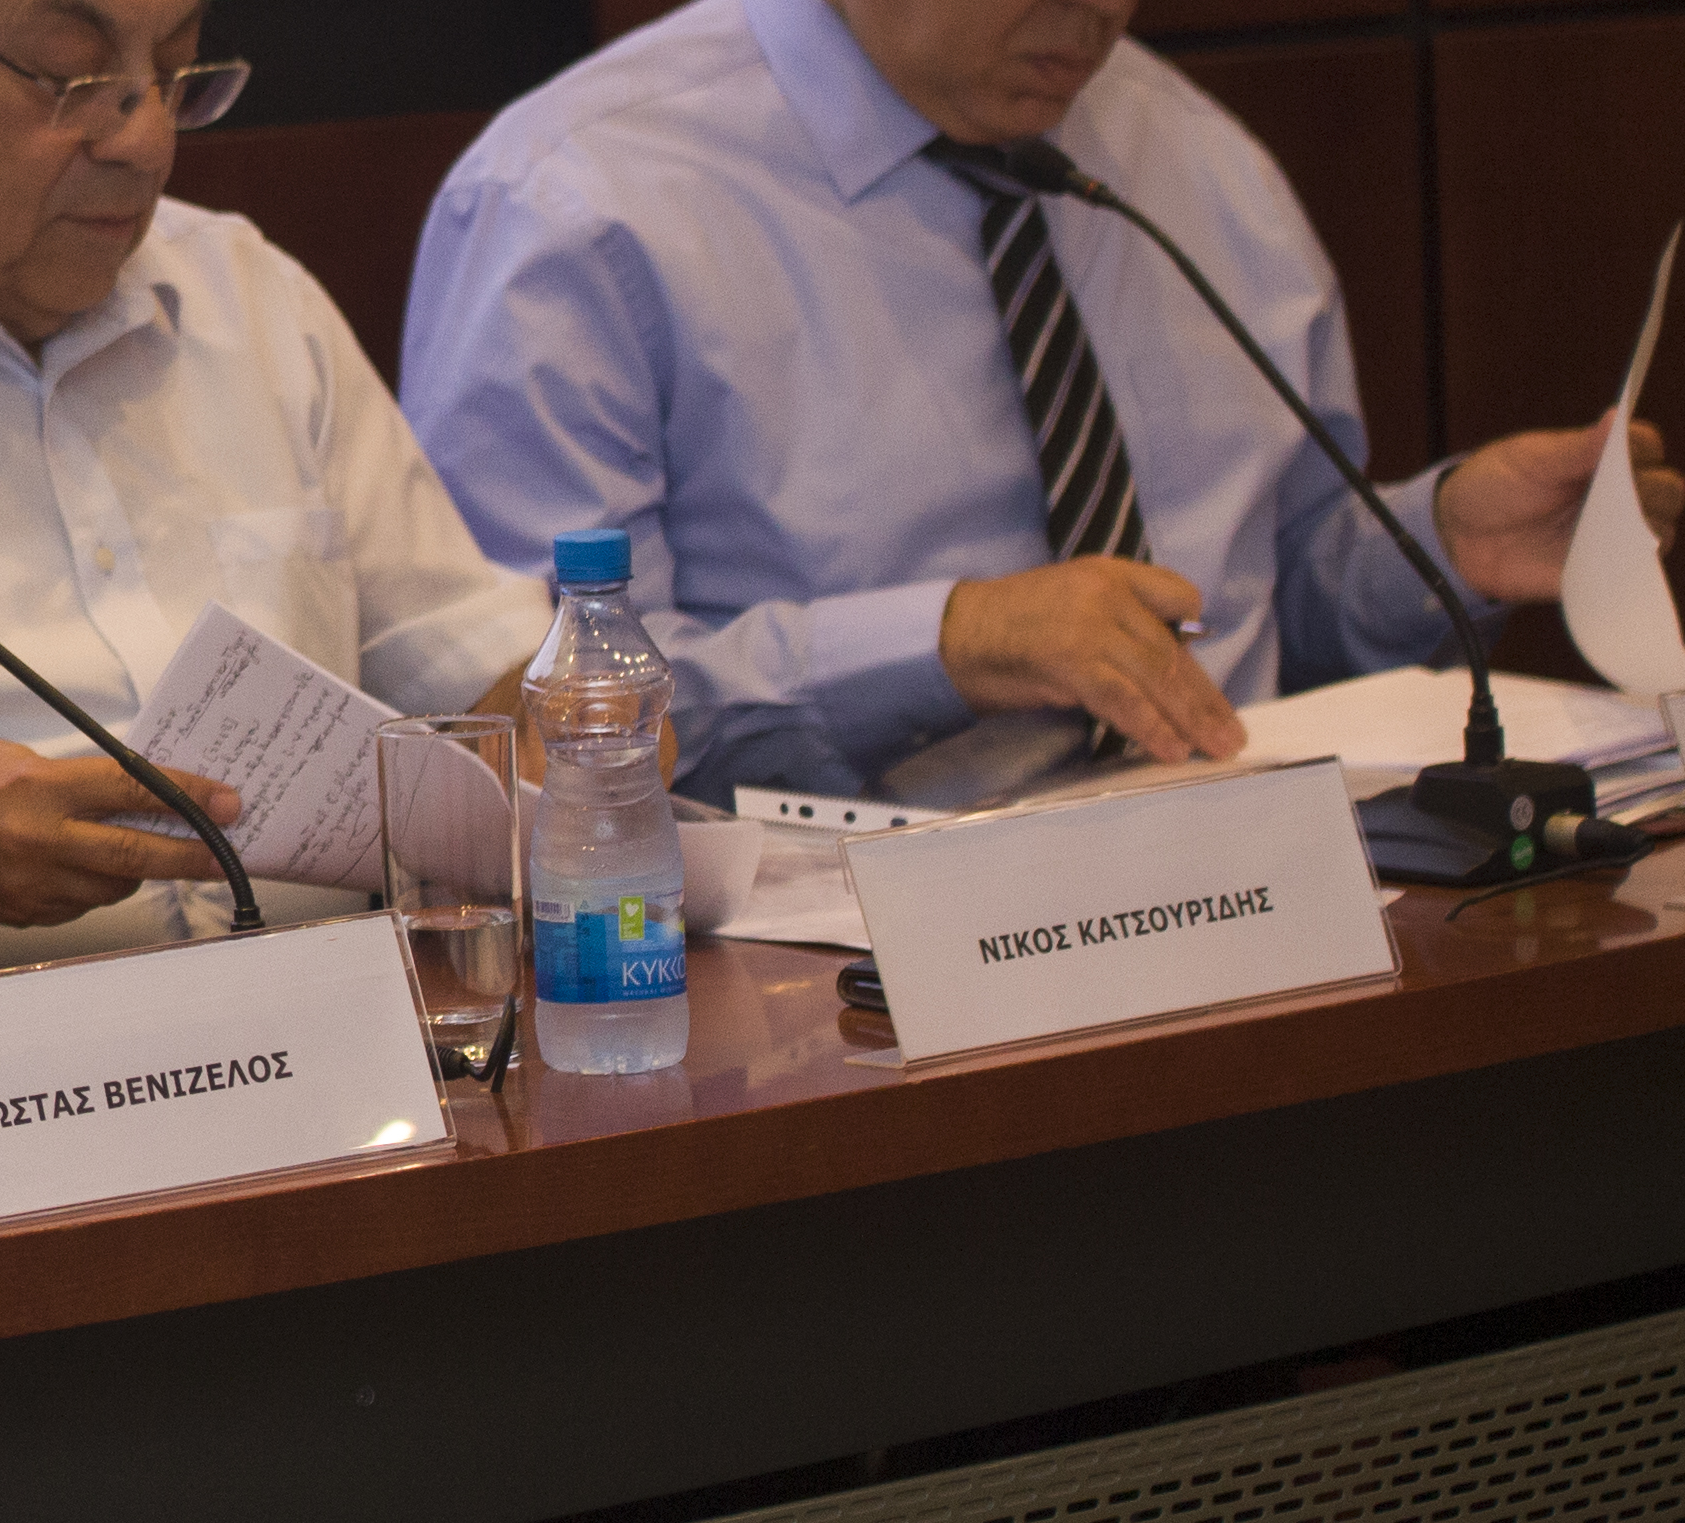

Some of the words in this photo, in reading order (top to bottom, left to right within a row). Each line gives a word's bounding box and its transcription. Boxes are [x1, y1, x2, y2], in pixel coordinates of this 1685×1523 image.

[978, 923, 1073, 966] ΝΙΚΟΣ
[1076, 886, 1275, 947] ΚΑΤΣΟΥΡΙΔΗΣ
[103, 1049, 294, 1111] ΒΕΝΙΖΕΛΟΣ
